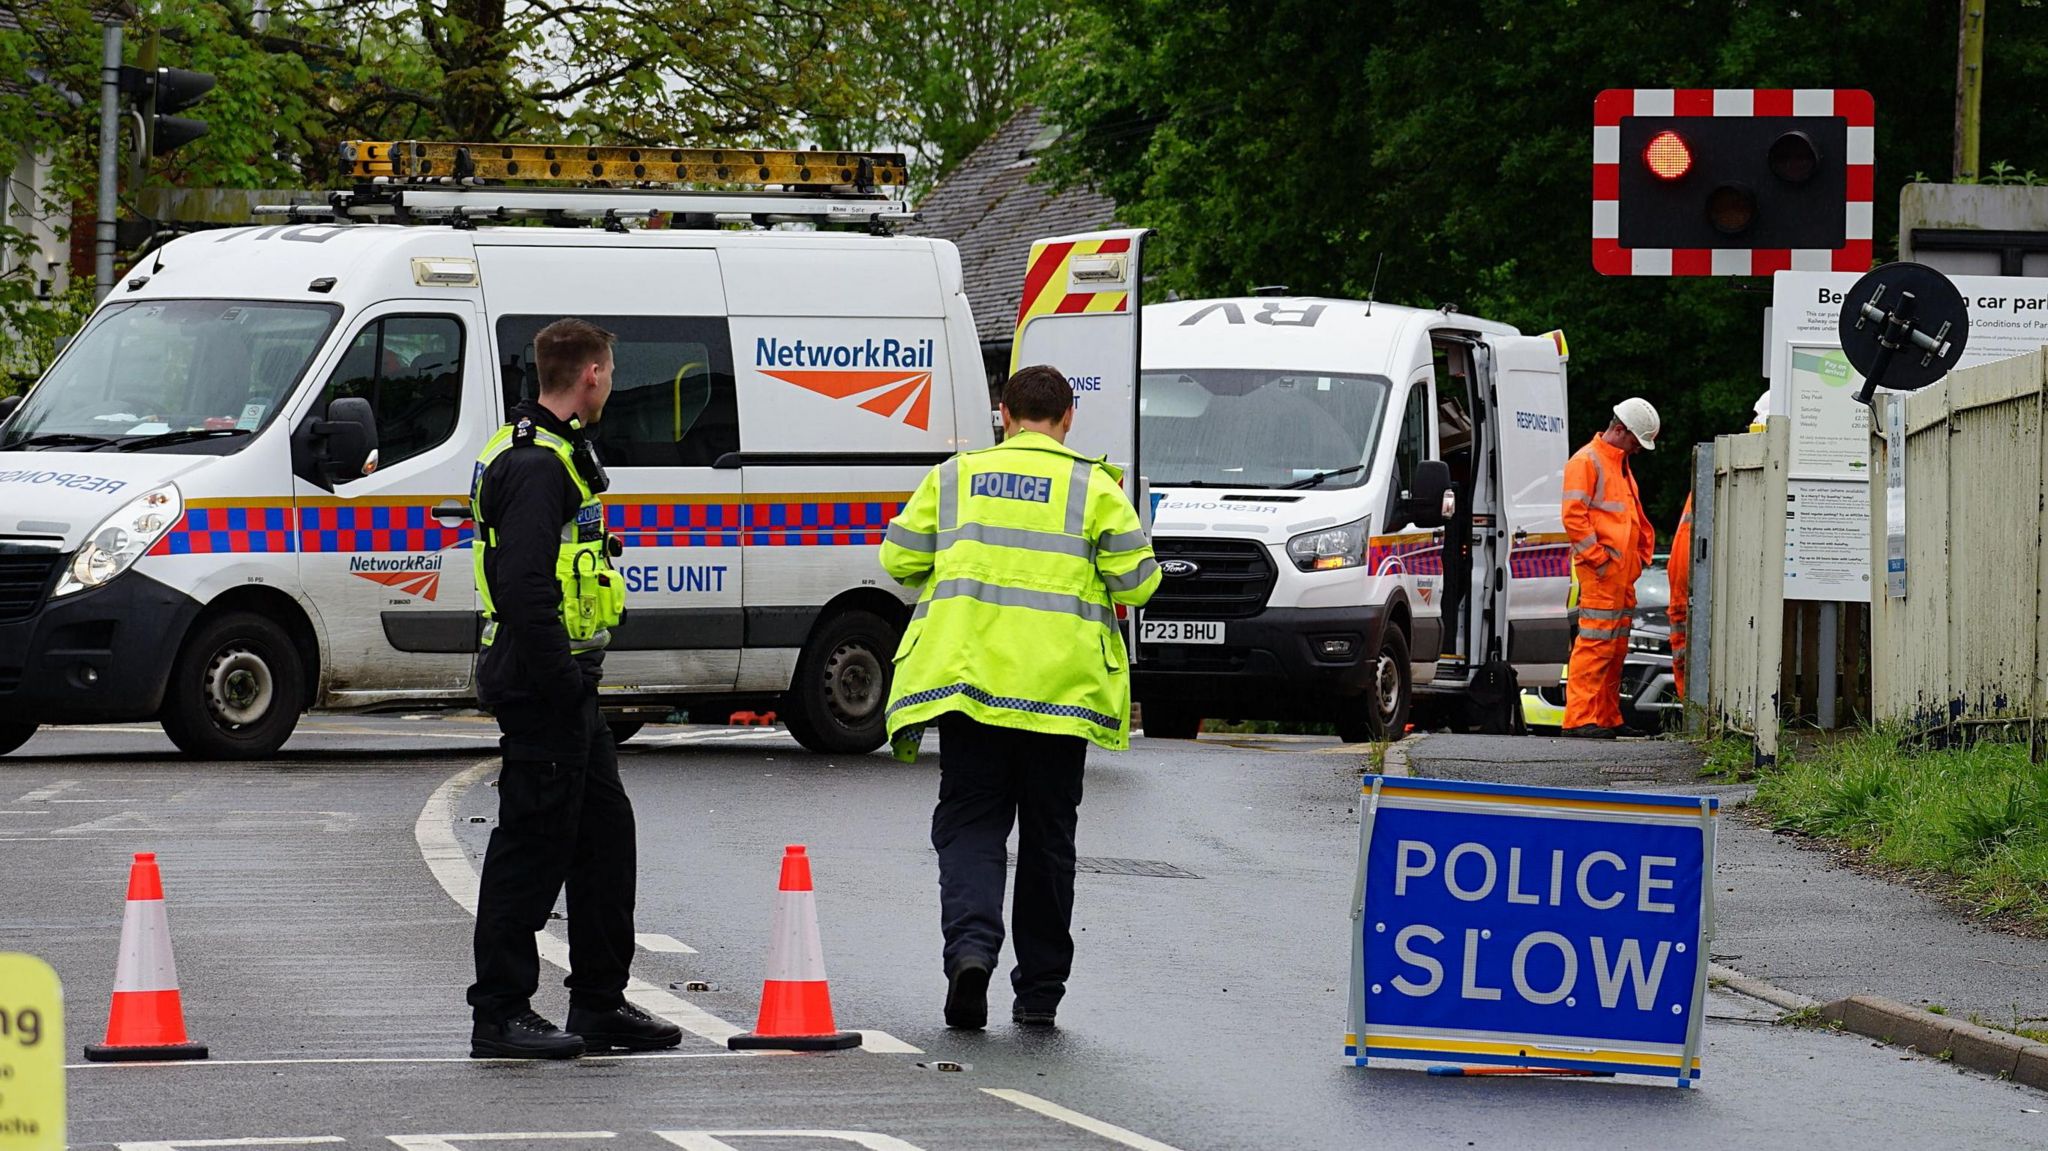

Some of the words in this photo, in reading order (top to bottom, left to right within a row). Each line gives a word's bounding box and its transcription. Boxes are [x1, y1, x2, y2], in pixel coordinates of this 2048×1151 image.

[1178, 302, 1328, 328] RV
[1977, 297, 2007, 309] car
[1976, 319, 2020, 328] Conditions
[2022, 320, 2032, 328] of
[973, 472, 1048, 502] POLICE
[667, 565, 728, 593] UNIT
[1163, 562, 1187, 573] Ford
[1183, 623, 1217, 640] BHU
[1394, 839, 1678, 914] POLICE
[1389, 923, 1672, 1011] SLOW
